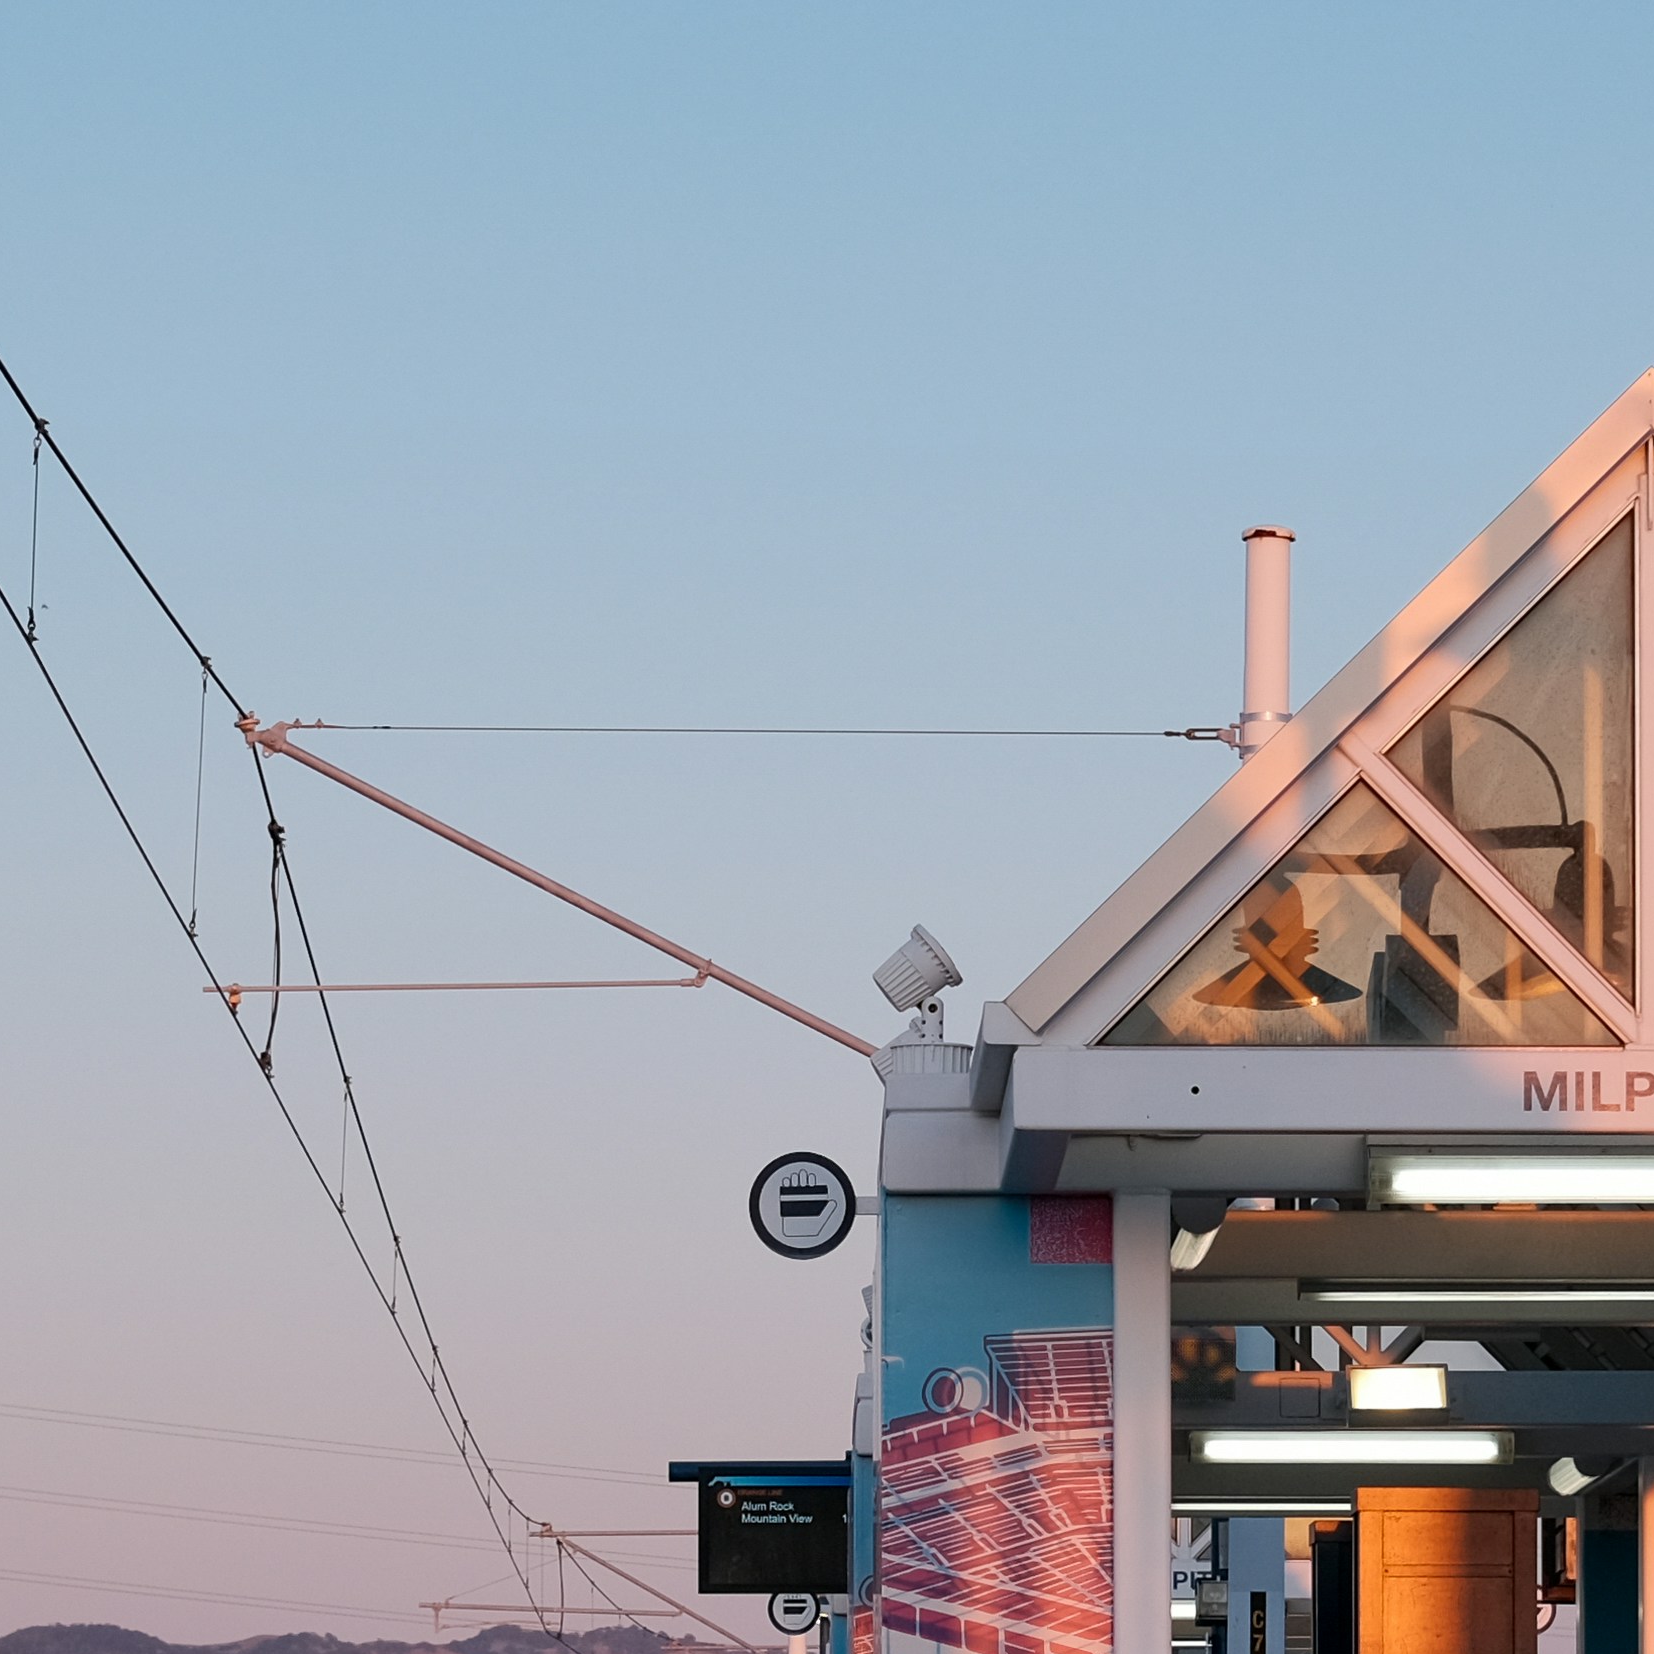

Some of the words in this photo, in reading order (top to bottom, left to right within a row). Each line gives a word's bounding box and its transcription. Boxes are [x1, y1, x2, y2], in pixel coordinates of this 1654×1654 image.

[741, 1501, 767, 1511] Alum
[769, 1501, 794, 1511] Rock
[741, 1513, 786, 1523] Mountain
[789, 1513, 813, 1523] View
